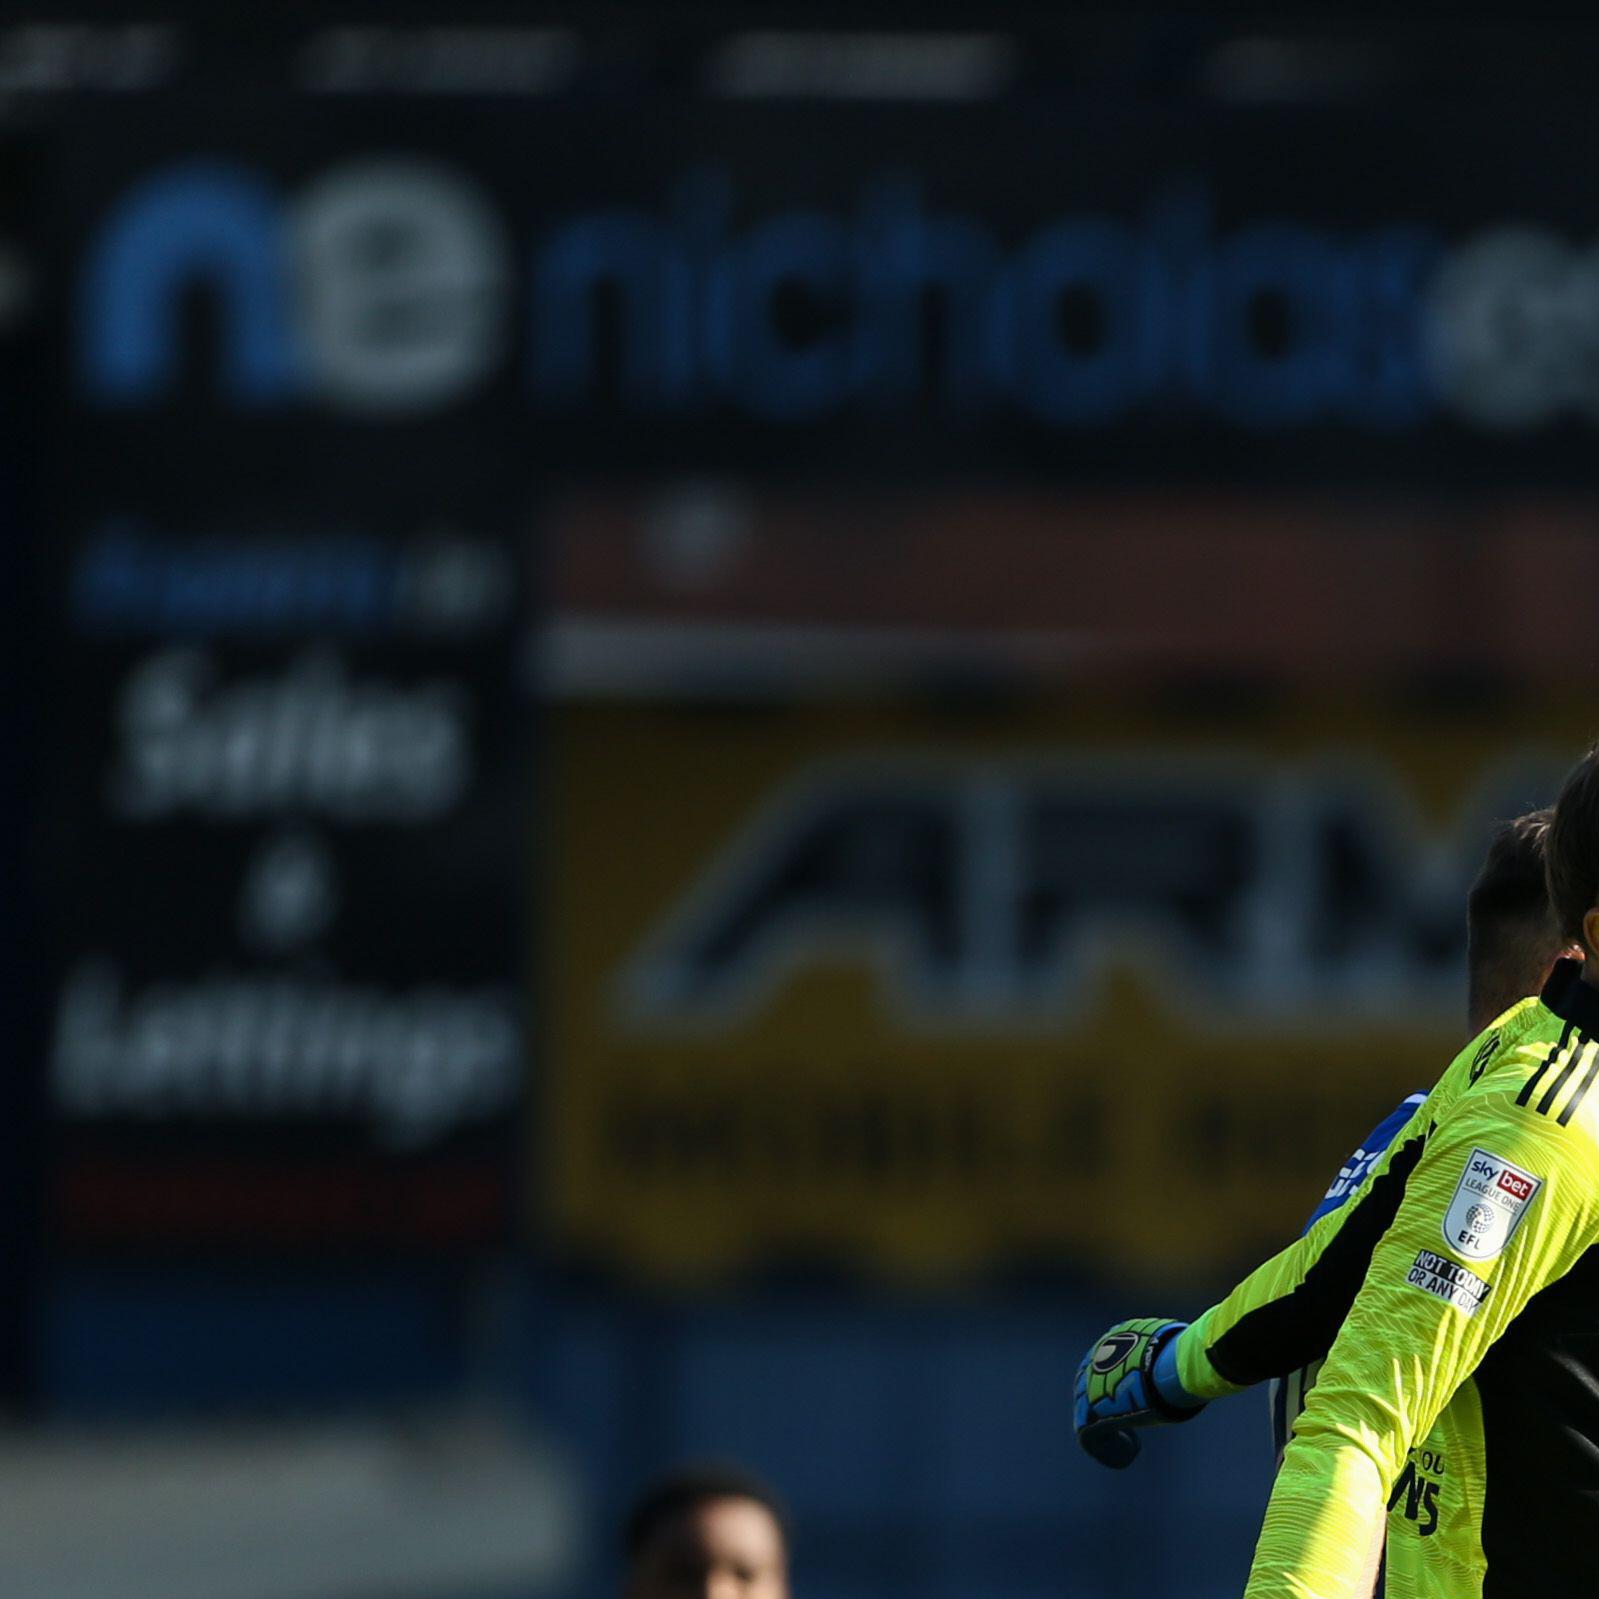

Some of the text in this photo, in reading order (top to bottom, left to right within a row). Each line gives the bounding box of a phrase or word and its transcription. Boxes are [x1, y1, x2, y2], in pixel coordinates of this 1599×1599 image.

[1466, 1178, 1501, 1201] LEAGUE
[1471, 1159, 1529, 1197] sky bet
[1458, 1229, 1480, 1250] EFL
[1408, 1267, 1426, 1287] OR
[1429, 1276, 1459, 1301] ANY
[1416, 1250, 1491, 1300] NOT TODAY
